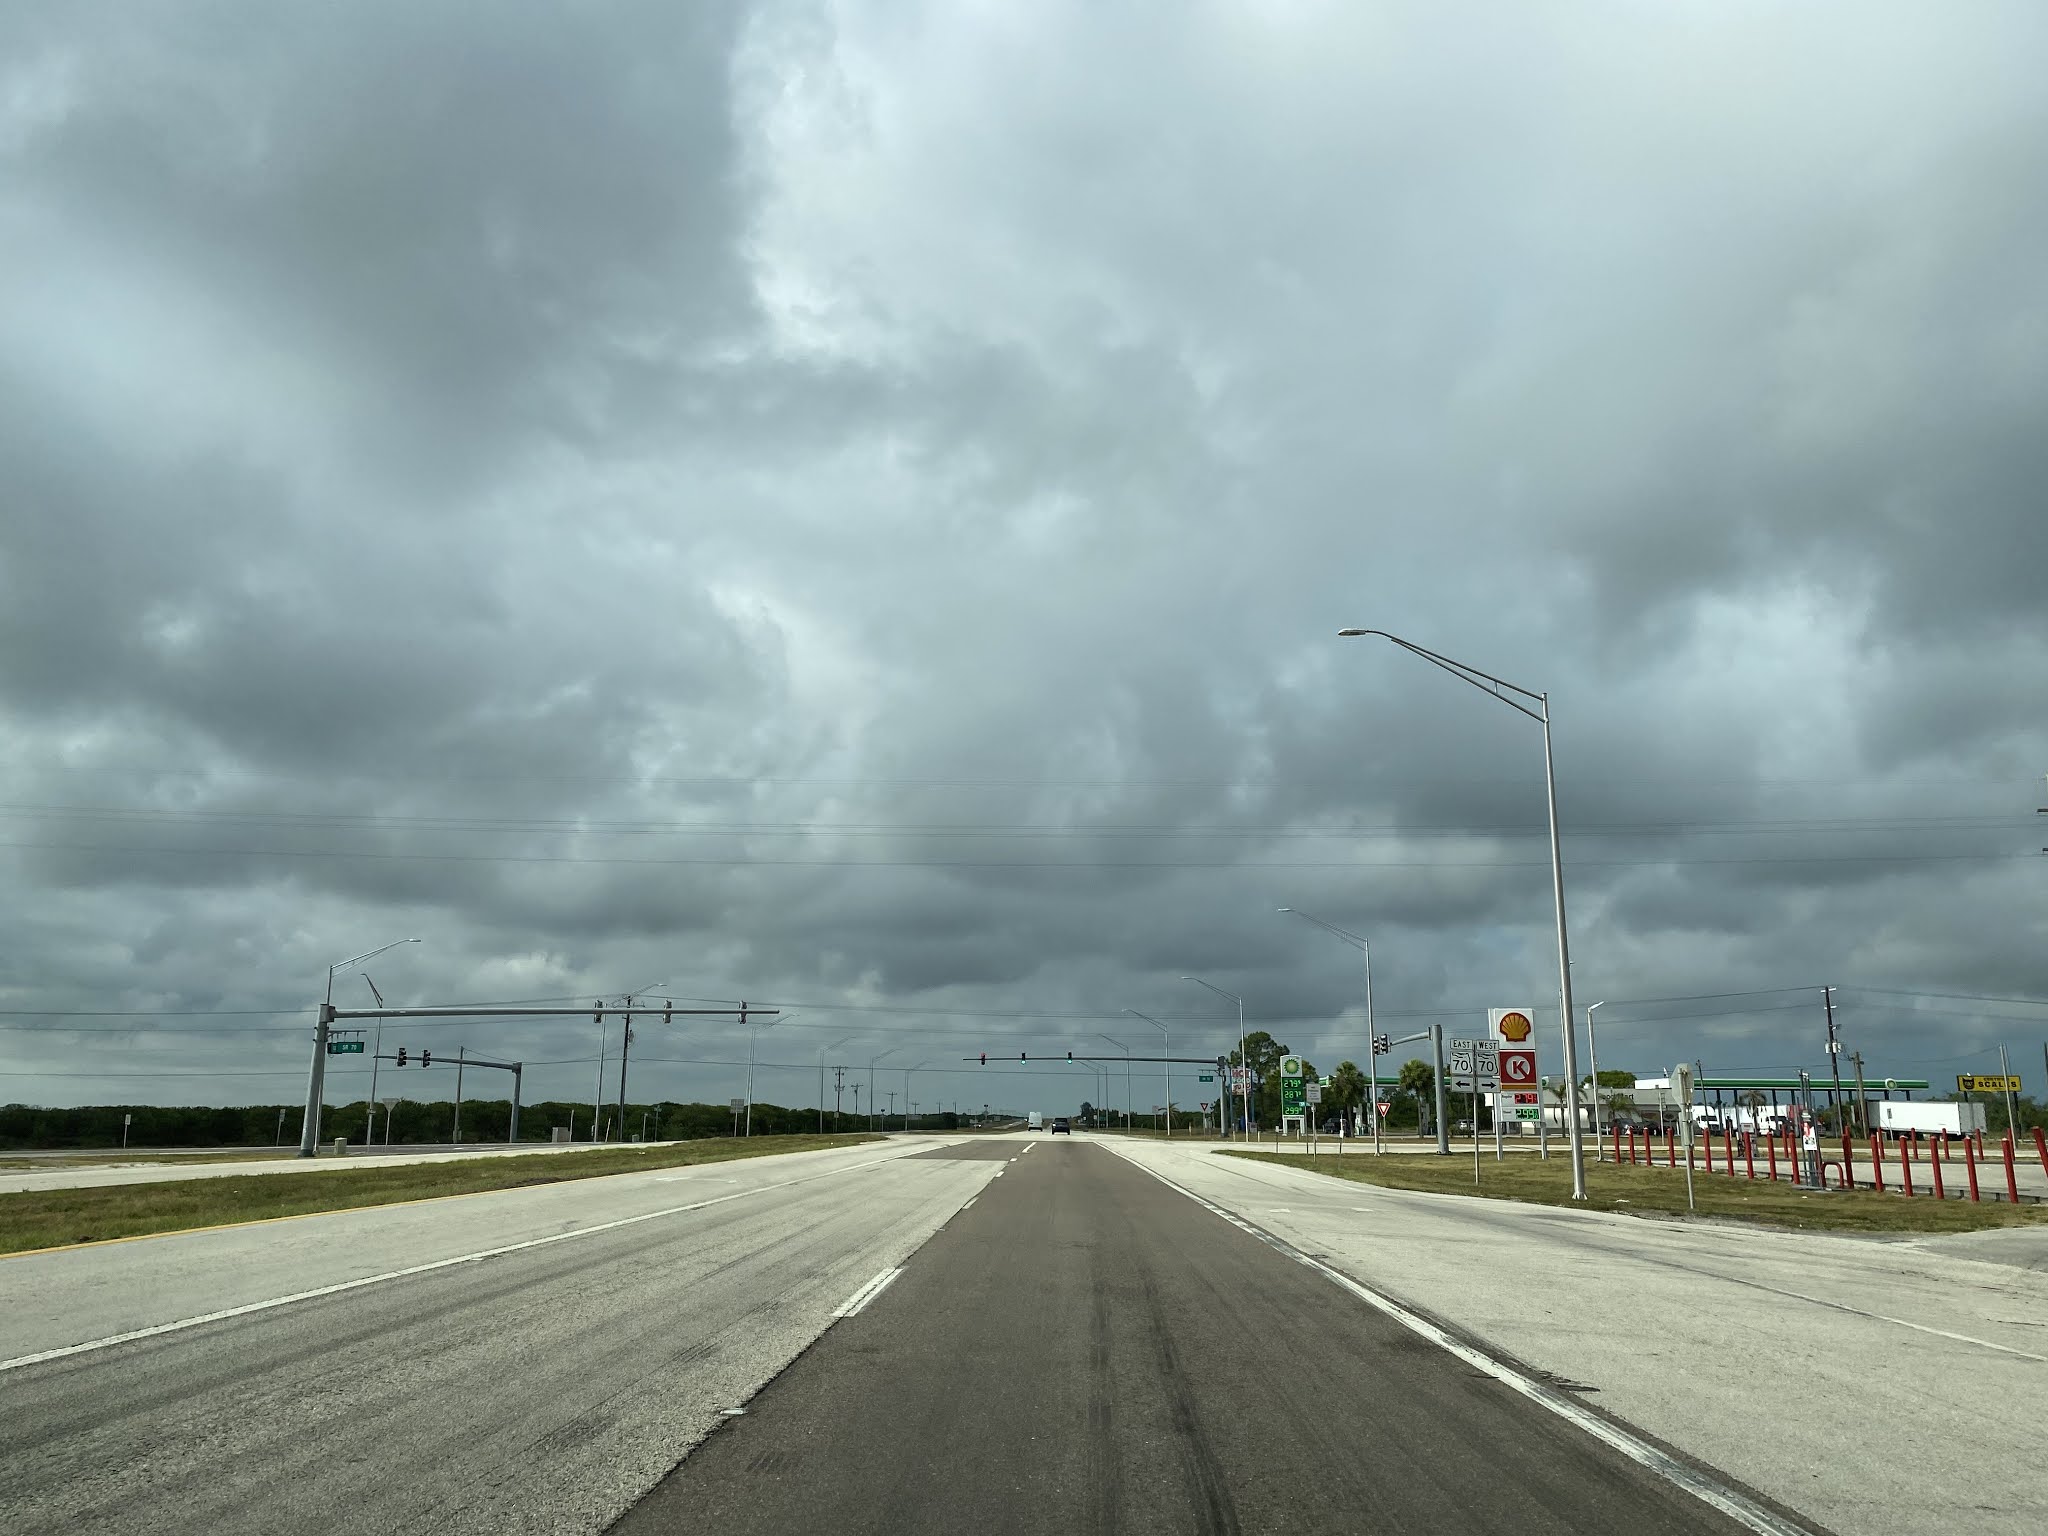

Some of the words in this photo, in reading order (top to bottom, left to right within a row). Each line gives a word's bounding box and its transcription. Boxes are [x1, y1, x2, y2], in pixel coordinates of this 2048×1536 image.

[1453, 1040, 1470, 1048] EAST
[1479, 1042, 1497, 1050] WEST
[1453, 1060, 1469, 1071] 70
[1478, 1061, 1494, 1072] 70
[1513, 1060, 1527, 1076] K
